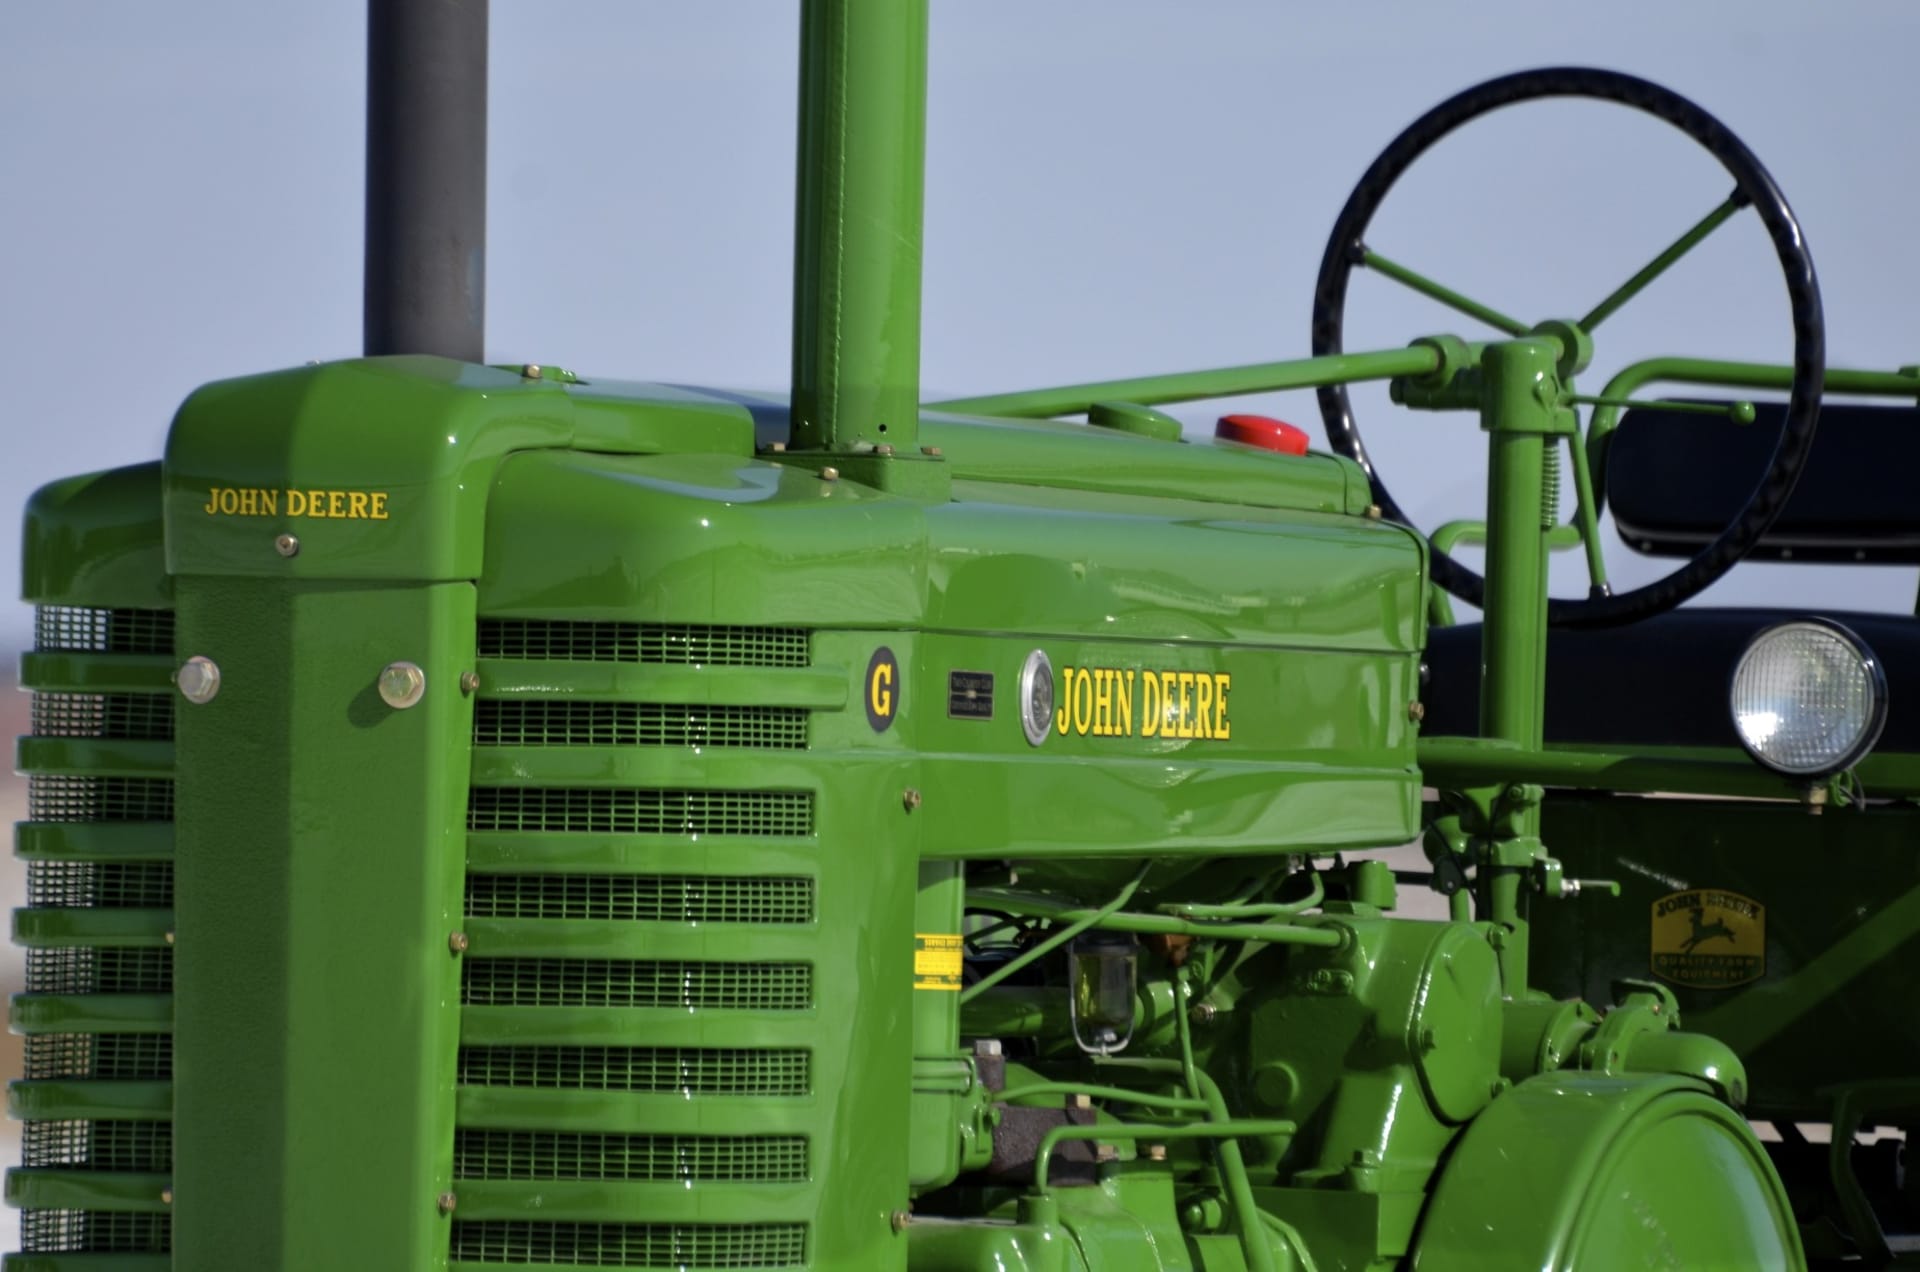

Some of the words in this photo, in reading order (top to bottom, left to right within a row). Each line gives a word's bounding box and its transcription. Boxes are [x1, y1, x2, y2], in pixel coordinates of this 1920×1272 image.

[205, 488, 279, 516] JOHN
[286, 490, 389, 520] DEERE
[870, 663, 892, 717] G
[1056, 667, 1135, 737] JOHN
[1141, 671, 1231, 740] DEERE
